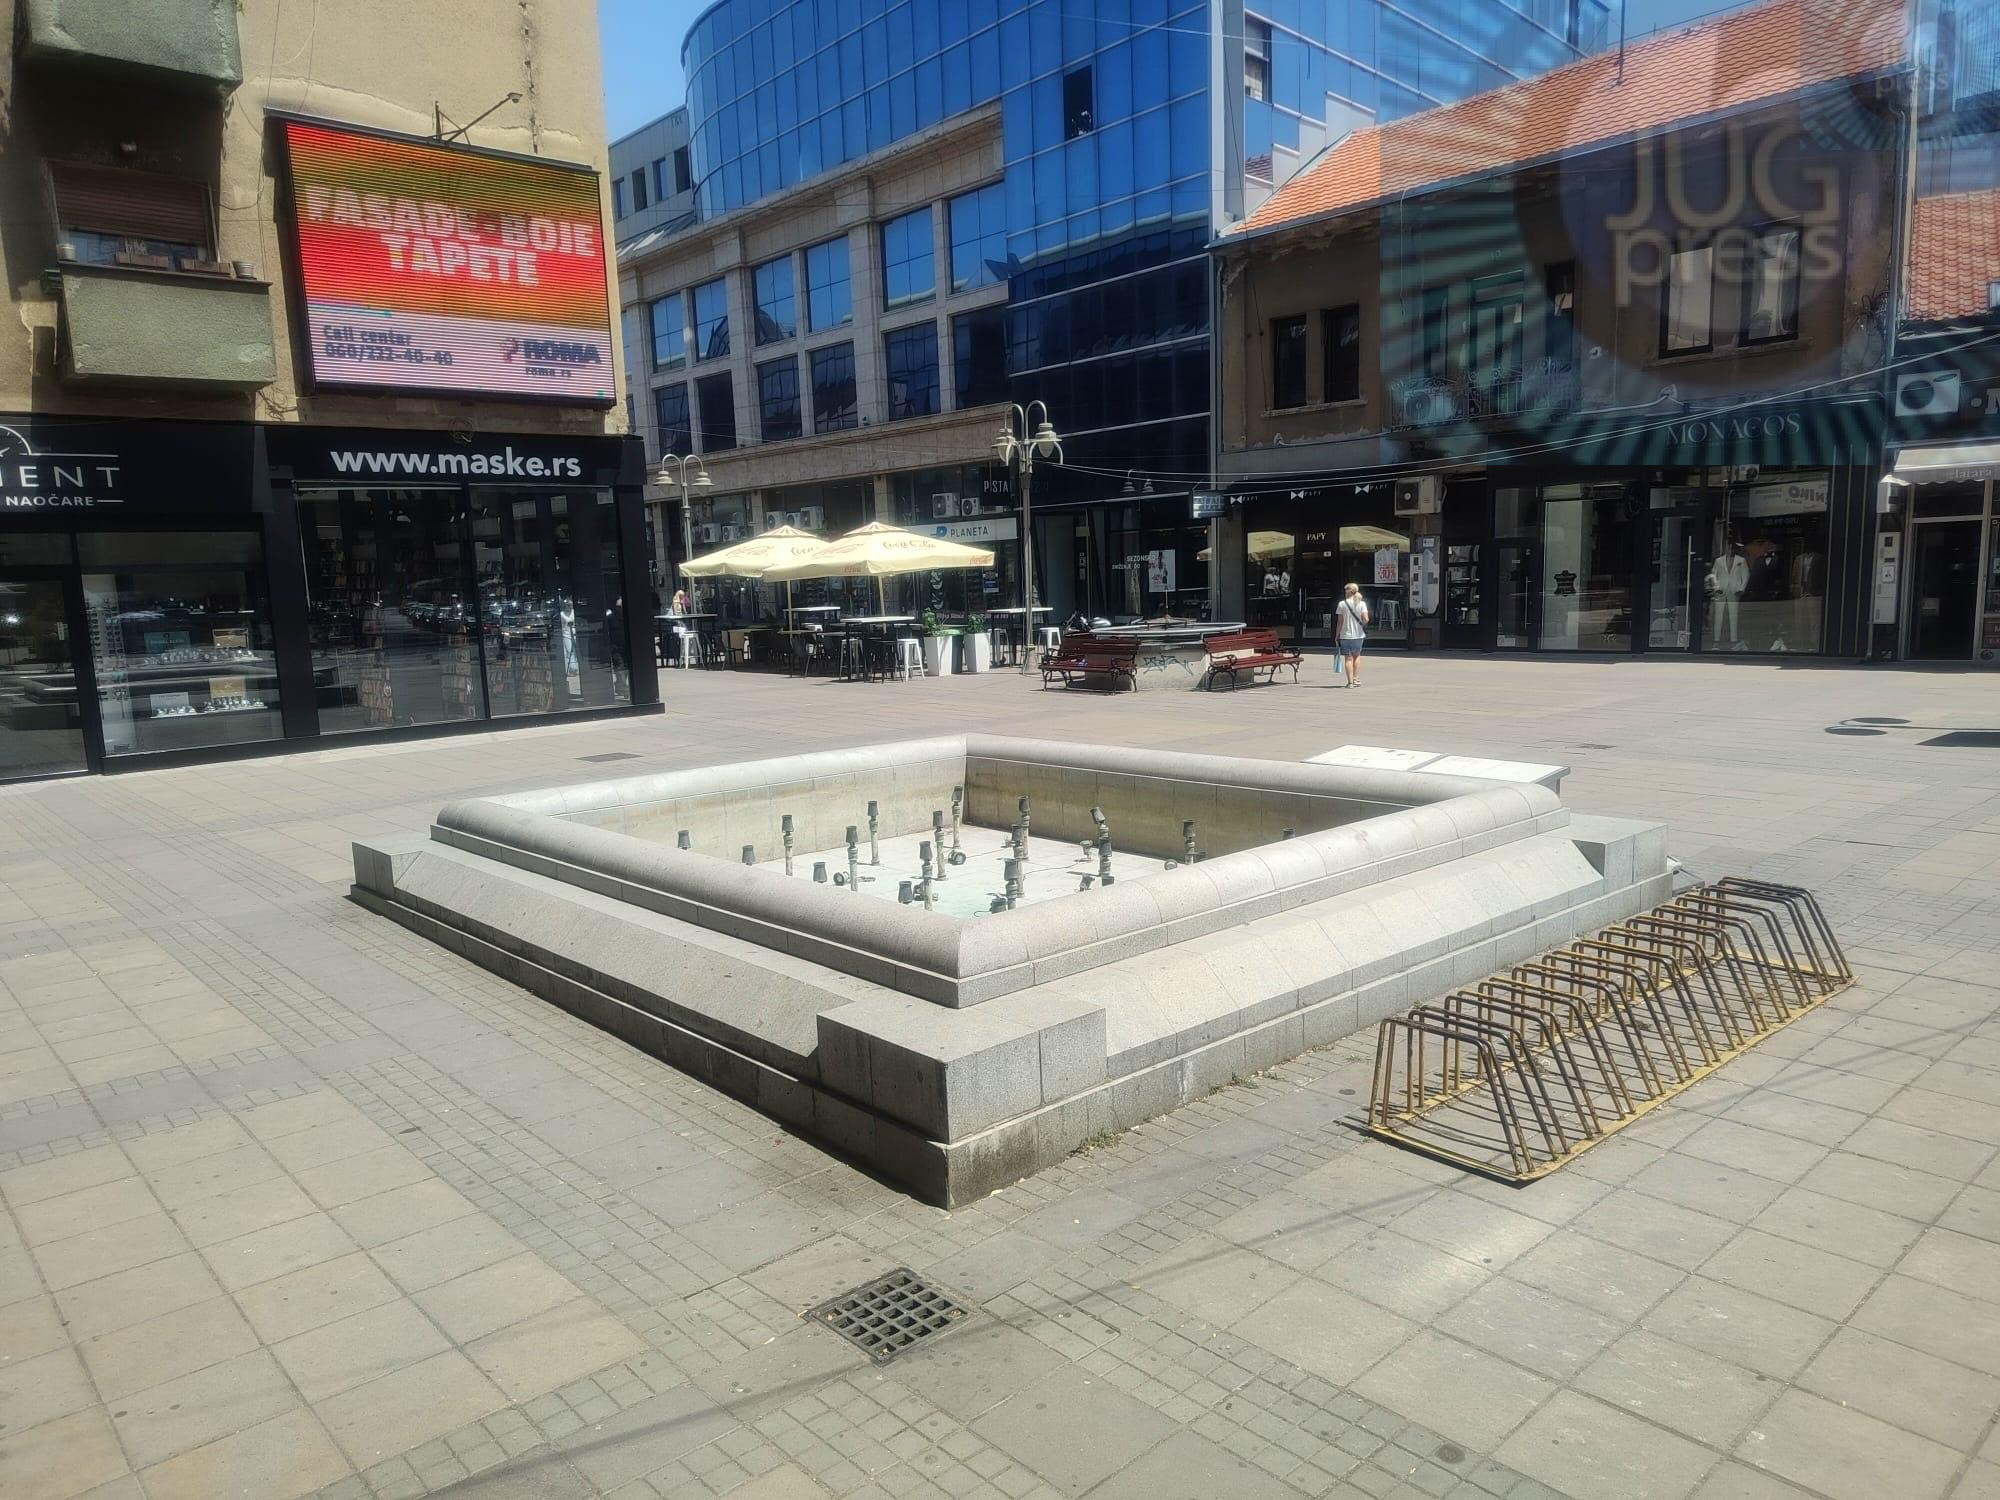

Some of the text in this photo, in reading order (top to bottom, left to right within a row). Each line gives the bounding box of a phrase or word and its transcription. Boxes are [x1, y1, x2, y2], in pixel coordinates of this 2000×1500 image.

[381, 232, 540, 288] TAPETE
[324, 325, 353, 341] Call
[330, 446, 582, 477] www.maske.rs
[0, 466, 121, 488] ENT
[5, 493, 94, 506] NAOČARE
[950, 526, 989, 538] PLANETA
[1306, 531, 1327, 541] PAPY
